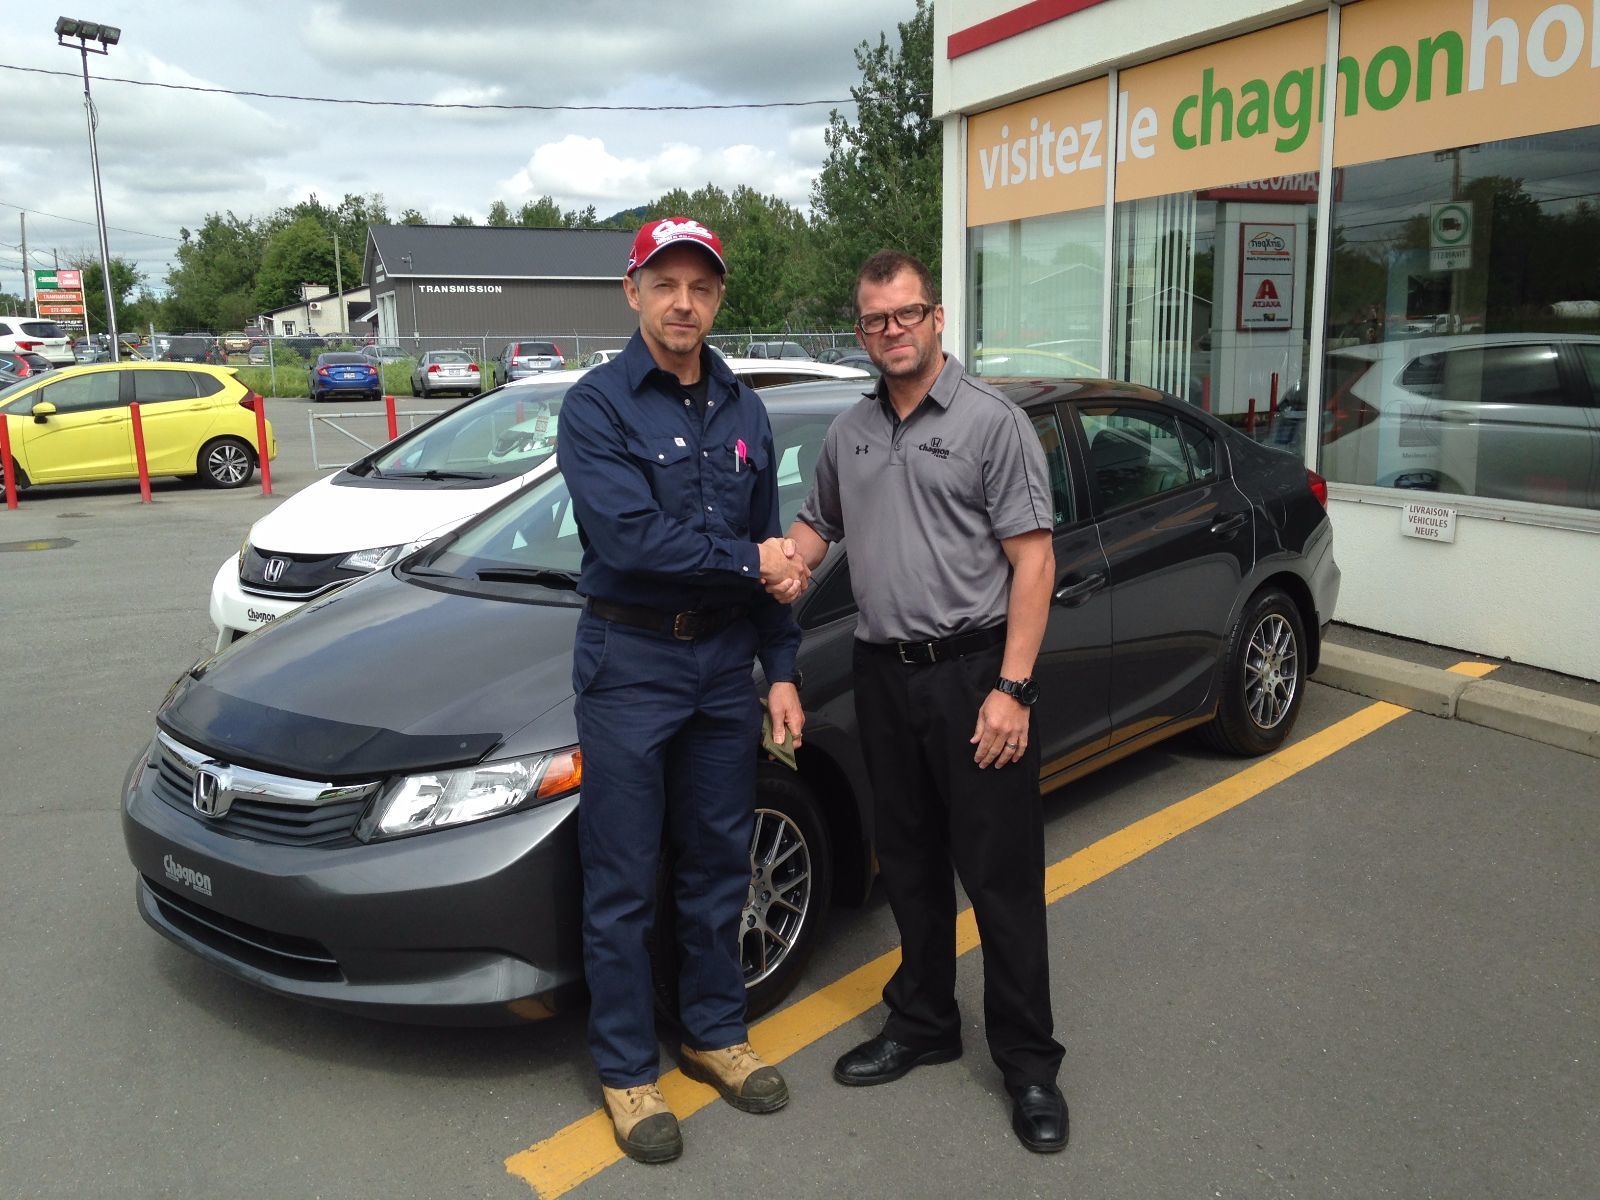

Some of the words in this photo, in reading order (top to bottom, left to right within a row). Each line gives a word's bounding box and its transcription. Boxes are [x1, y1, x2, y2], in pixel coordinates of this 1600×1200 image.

[978, 117, 1103, 190] visitez
[1117, 91, 1158, 163] le
[1172, 0, 1600, 153] chagnonho
[418, 285, 502, 293] TRANSMISSION
[918, 443, 950, 456] Chagnon
[1409, 504, 1449, 518] LIVRAISON
[1414, 526, 1439, 538] NEUFS
[247, 608, 276, 622] Chagnon
[163, 854, 212, 890] Chagnon
